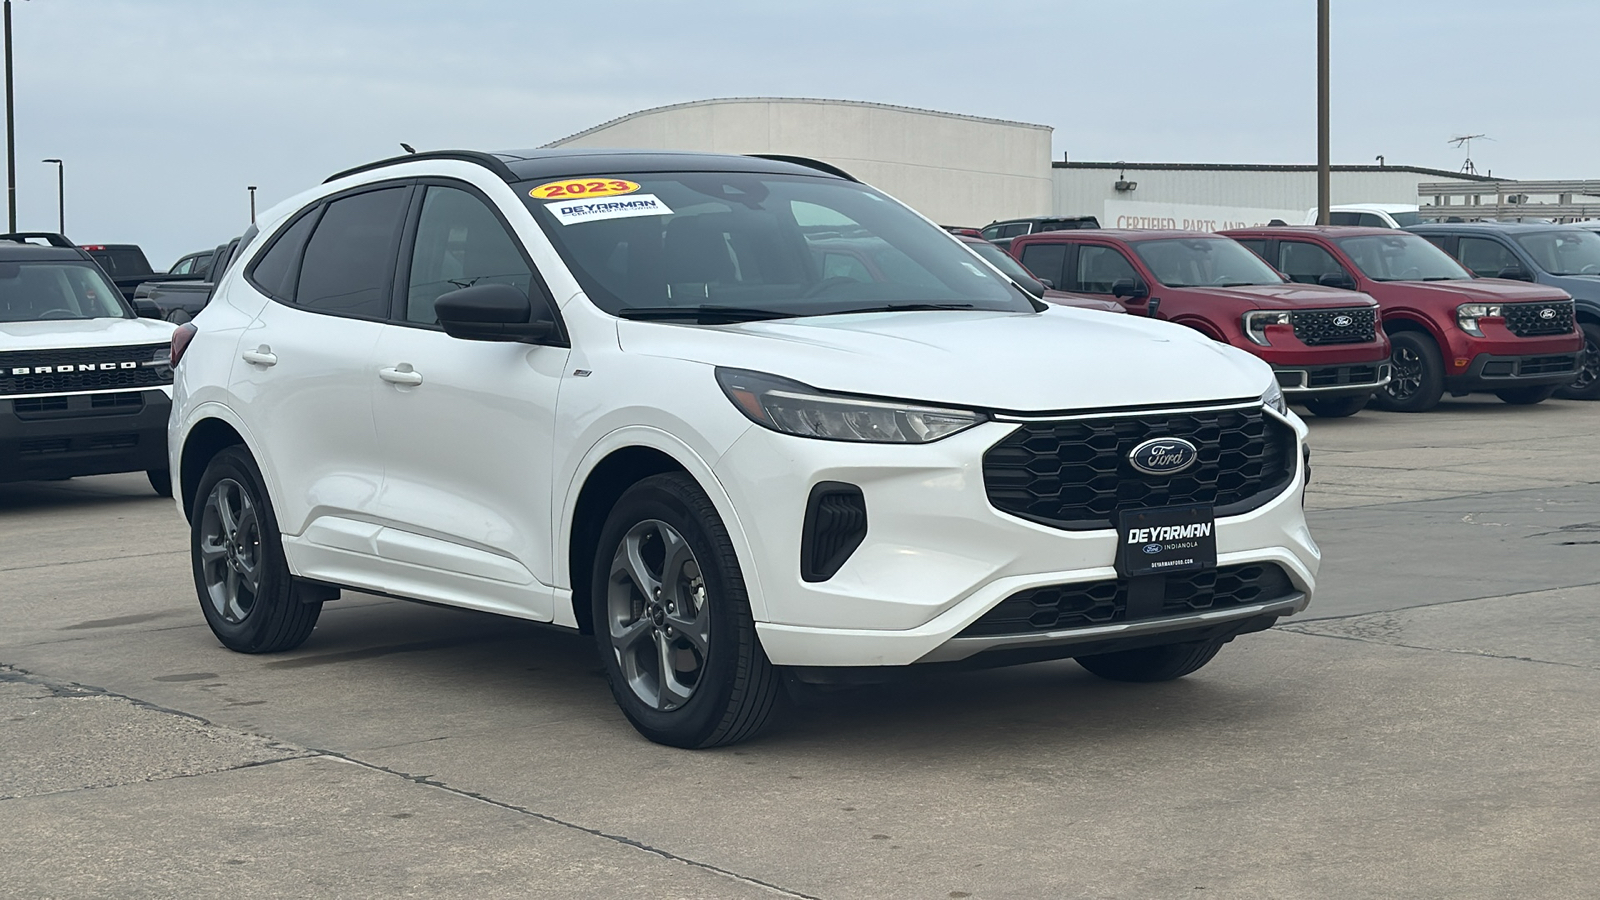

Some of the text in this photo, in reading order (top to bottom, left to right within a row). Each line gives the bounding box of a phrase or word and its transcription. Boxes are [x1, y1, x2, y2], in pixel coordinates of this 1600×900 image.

[544, 181, 631, 197] 2023
[560, 200, 656, 215] DEYARMAN
[571, 208, 613, 216] CERTIFIED
[1116, 215, 1176, 230] CERTIFIED
[1183, 218, 1216, 233] PARTS
[1222, 220, 1246, 232] AND
[12, 361, 137, 375] BRONCO
[1147, 445, 1184, 467] Ford
[1128, 522, 1211, 544] DEYARMAN
[1164, 541, 1199, 550] INDIANOLA
[1151, 558, 1194, 568] DEYARMANFORD.COM
